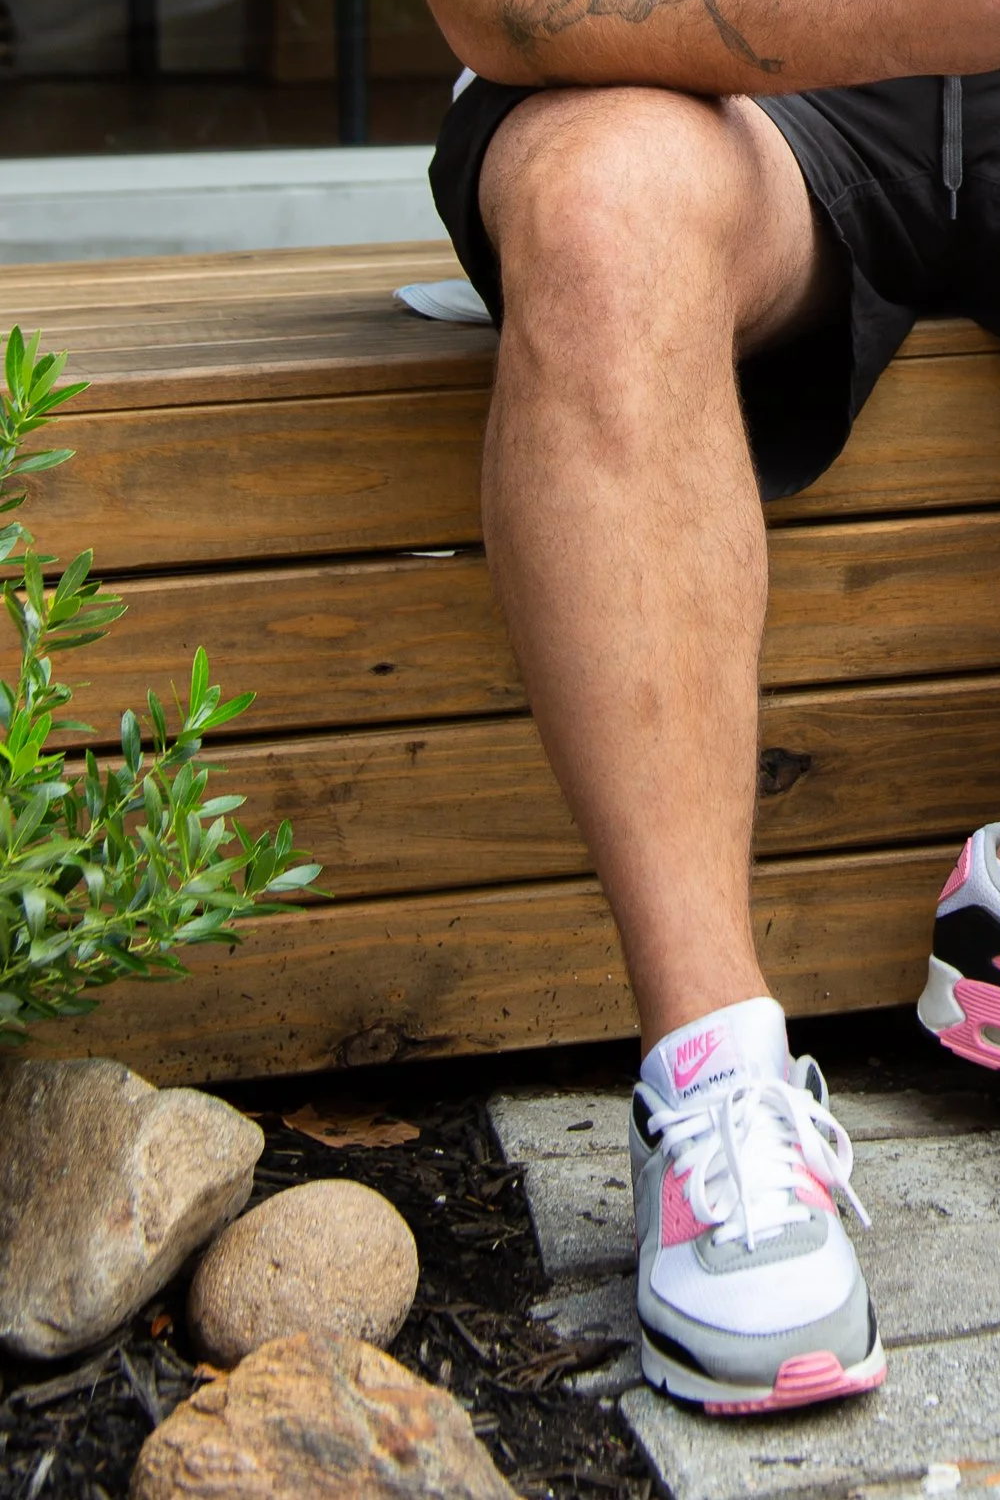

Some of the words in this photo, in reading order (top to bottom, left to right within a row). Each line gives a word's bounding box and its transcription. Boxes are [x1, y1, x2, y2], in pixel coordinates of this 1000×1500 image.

[676, 1028, 715, 1066] NIKE
[683, 1083, 700, 1099] AIR
[709, 1068, 736, 1084] MAX
